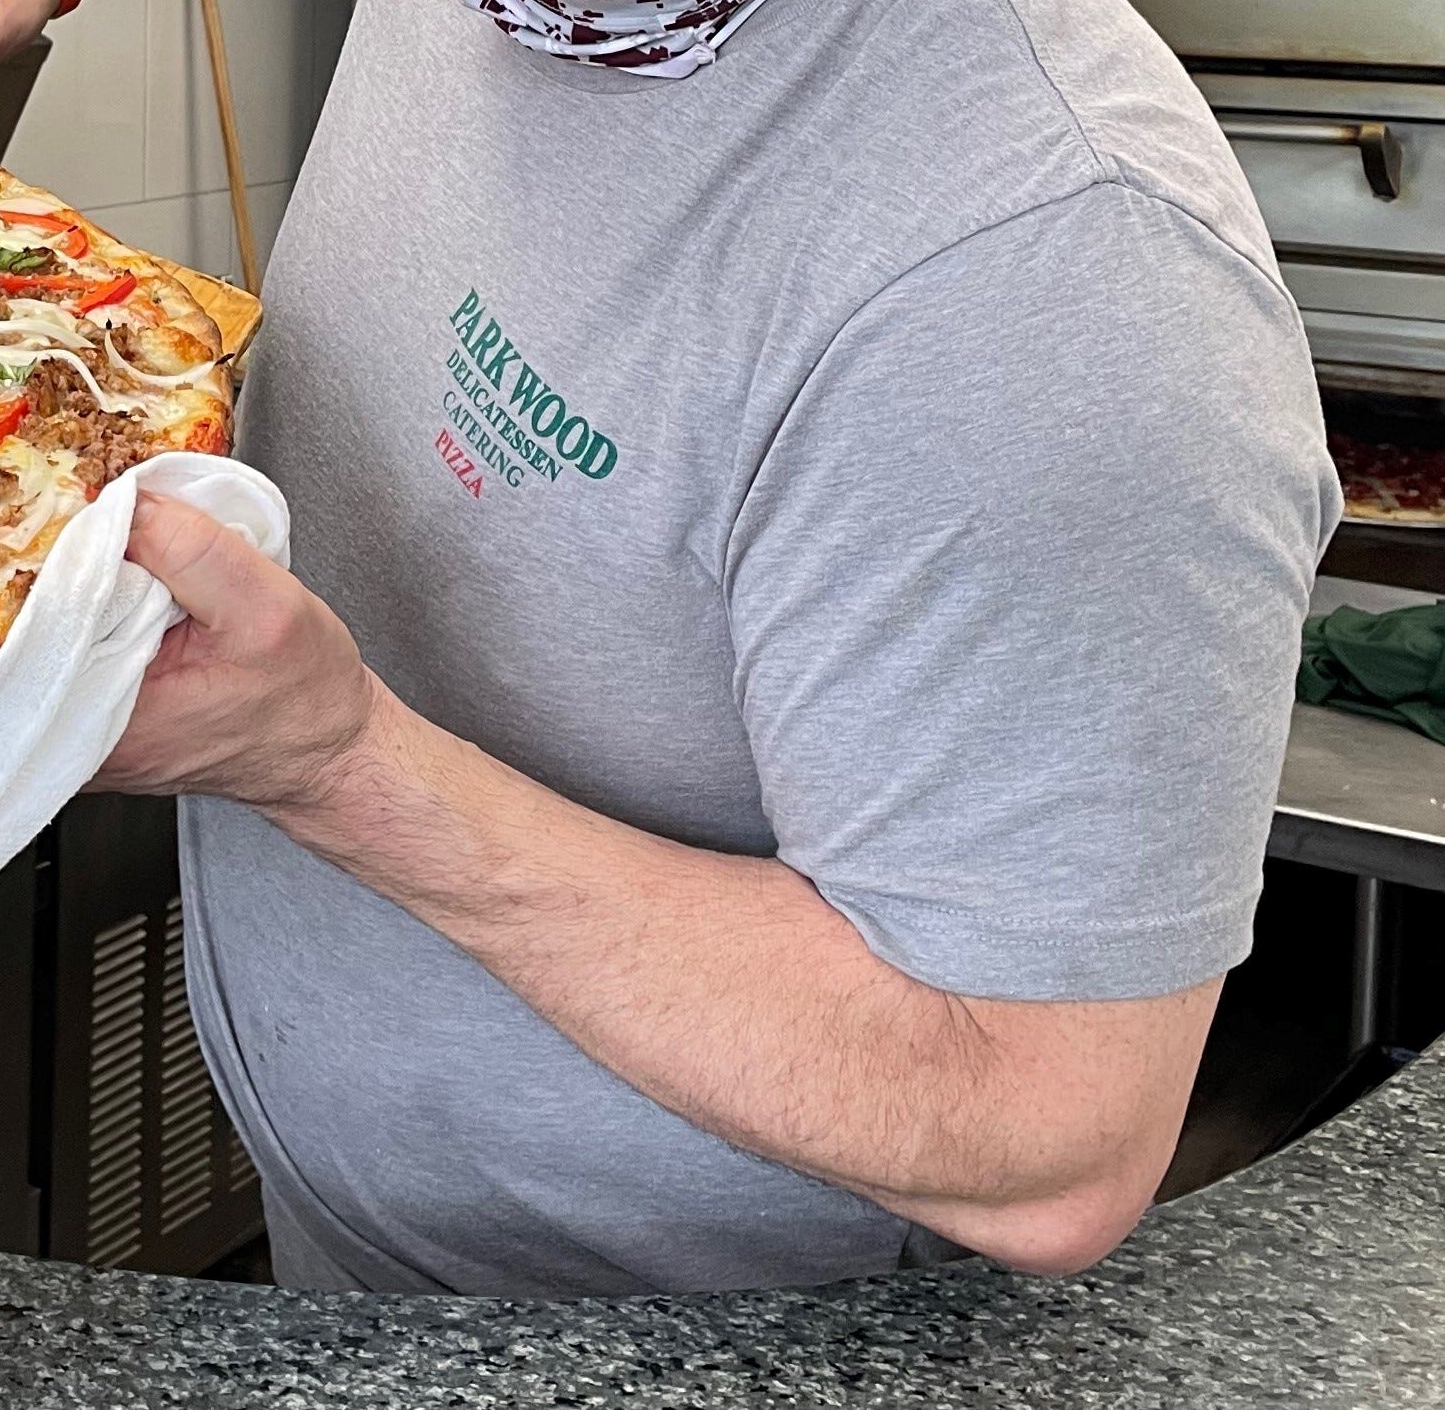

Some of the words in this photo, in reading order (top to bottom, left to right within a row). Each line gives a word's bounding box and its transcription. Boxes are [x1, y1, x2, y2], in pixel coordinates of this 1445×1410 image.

[443, 390, 525, 488] CATERING
[446, 348, 564, 483] DELICATESSEN
[450, 287, 522, 391] PARK
[509, 361, 618, 480] WOOD
[434, 427, 484, 500] PIZZA
